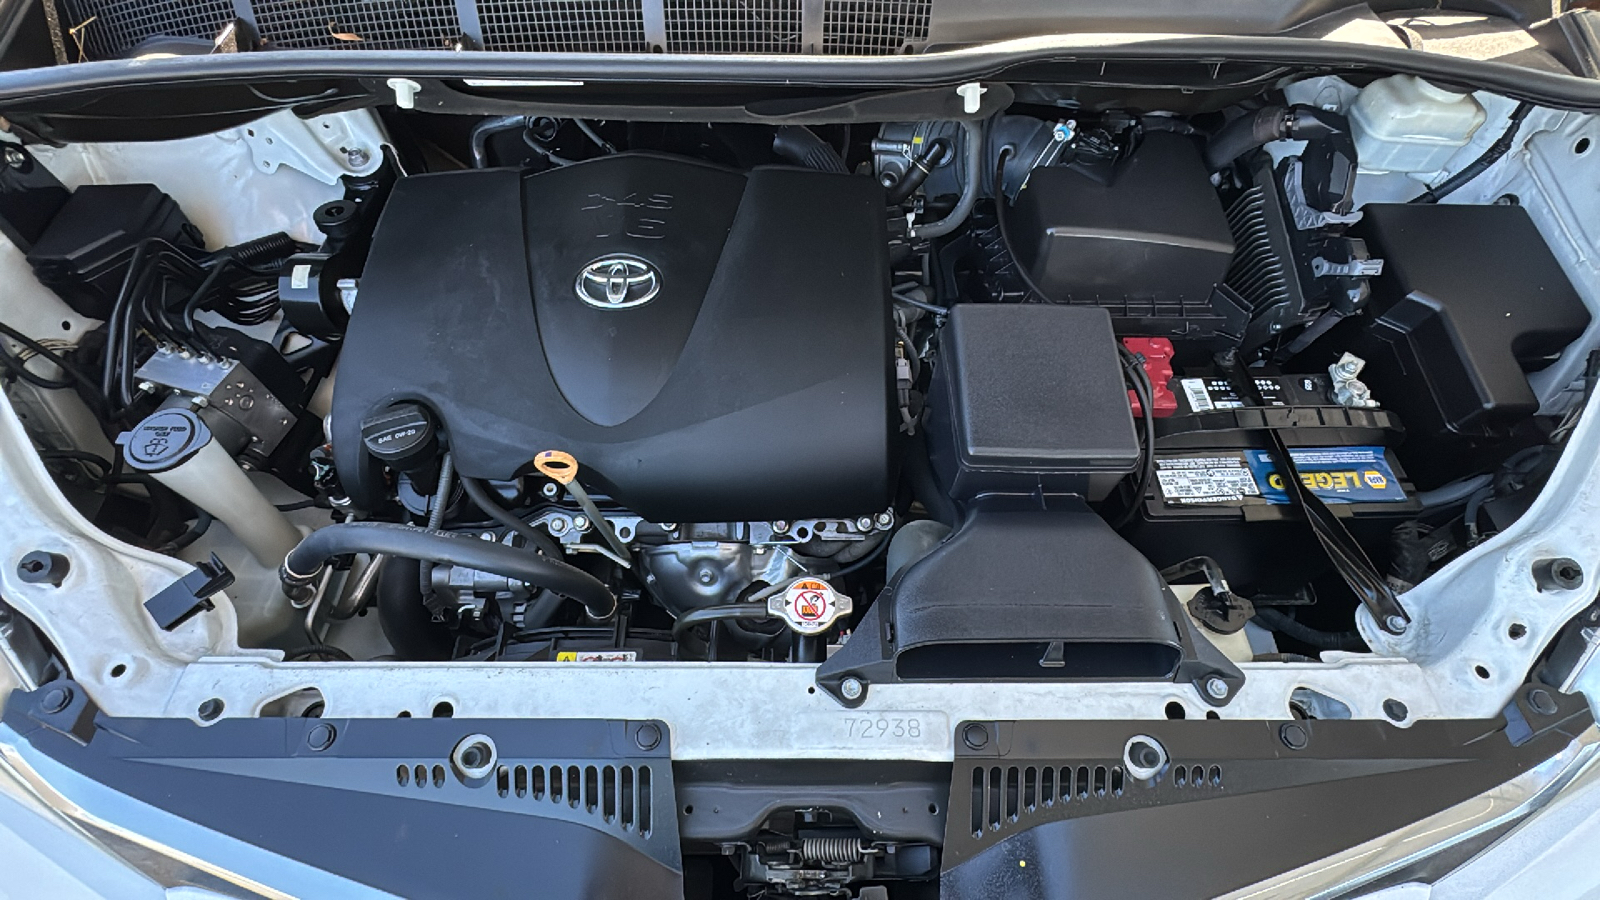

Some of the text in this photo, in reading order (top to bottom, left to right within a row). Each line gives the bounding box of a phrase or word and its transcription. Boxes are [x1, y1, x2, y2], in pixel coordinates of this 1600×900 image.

[378, 434, 392, 444] SAE
[1269, 471, 1361, 490] LEGED
[844, 718, 921, 739] 72938
